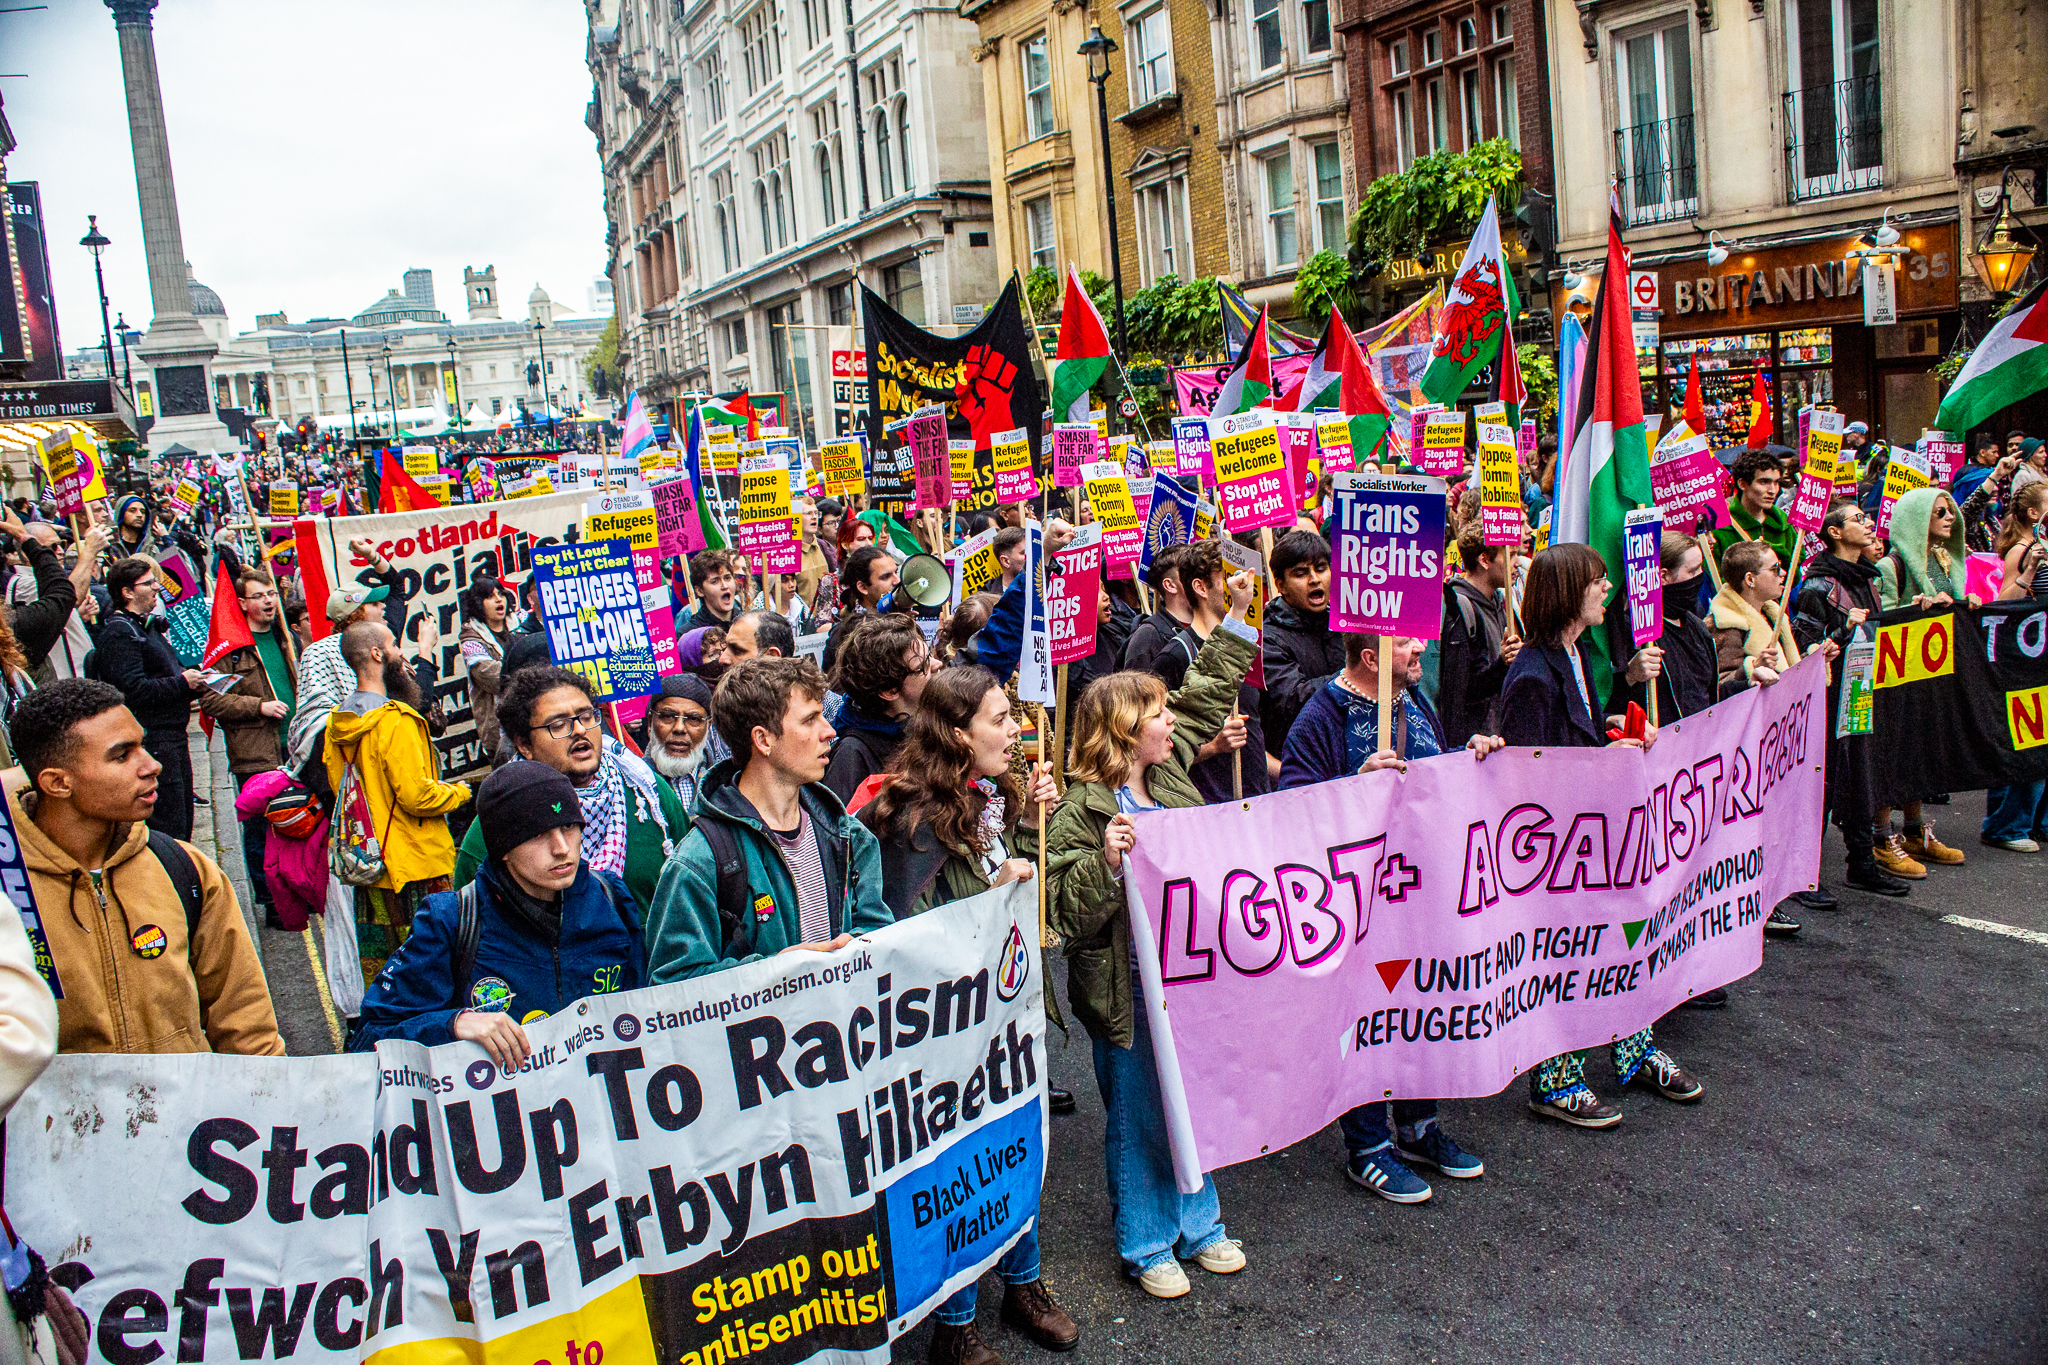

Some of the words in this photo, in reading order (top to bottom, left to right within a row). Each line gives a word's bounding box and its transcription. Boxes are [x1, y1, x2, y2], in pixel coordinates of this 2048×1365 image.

[1391, 252, 1448, 281] SILER
[1909, 252, 1950, 281] 35
[1675, 257, 1868, 315] BRITANNIA
[1873, 315, 1894, 323] BRITANNIA
[877, 341, 968, 390] Socialist
[1857, 391, 1867, 400] 35
[9, 406, 30, 417] FOR
[33, 405, 57, 416] OUR
[1124, 402, 1136, 412] 20
[1236, 416, 1251, 424] STAND
[1245, 420, 1262, 430] RACISM
[912, 418, 943, 440] SMASH
[1058, 432, 1090, 443] SMASH
[1174, 424, 1204, 437] Trans
[1320, 424, 1348, 435] Refugees
[1414, 427, 1425, 436] THE
[1426, 426, 1464, 436] Refugees
[1178, 439, 1212, 456] Rights
[1216, 434, 1276, 458] Refugees
[1322, 434, 1348, 444] welcome
[1426, 436, 1461, 444] welcome
[822, 445, 849, 458] SMASH
[916, 442, 931, 458] THE
[932, 438, 947, 457] FAR
[996, 443, 1028, 457] Refugees
[1059, 444, 1077, 455] THE
[1078, 444, 1094, 454] FAR
[1324, 448, 1340, 458] Stop
[1340, 447, 1350, 456] the
[1424, 450, 1444, 460] Stop
[1446, 449, 1458, 458] the
[1481, 445, 1512, 466] Oppose
[1674, 446, 1694, 459] RACISM
[1928, 442, 1963, 454] JUSTICE
[405, 454, 429, 464] Oppose
[405, 462, 429, 471] Tommy
[824, 457, 856, 470] FASCISM
[996, 455, 1028, 468] welcome
[1058, 456, 1086, 468] RIGHT
[1180, 456, 1202, 470] Now
[1220, 452, 1278, 476] welcome
[1326, 458, 1337, 468] far
[1338, 456, 1352, 468] right
[1424, 460, 1436, 468] far
[1437, 460, 1458, 470] right
[1672, 458, 1691, 470] loud
[1928, 454, 1946, 462] FOR
[834, 468, 862, 482] RACISM
[920, 458, 943, 478] RIGHT
[1482, 466, 1512, 486] Tommy
[1676, 466, 1700, 480] clear:
[65, 476, 79, 492] the
[998, 473, 1020, 485] Stop
[1020, 470, 1030, 481] the
[1890, 465, 1928, 489] Refugees
[507, 488, 532, 500] Oppose
[998, 485, 1014, 496] far
[1014, 482, 1032, 495] right
[1088, 481, 1122, 498] Oppose
[1224, 483, 1258, 502] Stop
[1258, 476, 1280, 490] the
[1654, 472, 1715, 500] Refugees
[1812, 481, 1826, 500] the
[1842, 486, 1855, 494] hate
[271, 498, 290, 506] Tommy
[1482, 486, 1520, 504] Robinson
[1658, 488, 1717, 514] welcome
[271, 506, 297, 514] Robinson
[622, 500, 642, 508] RACISM
[672, 497, 692, 514] FAR
[1092, 498, 1125, 513] Tommy
[1228, 500, 1250, 520] far
[1253, 494, 1284, 516] right
[740, 506, 789, 522] Robinson
[1098, 512, 1138, 529] Robinson
[1336, 492, 1420, 535] Trans
[1483, 508, 1498, 521] Stop
[1498, 508, 1518, 520] fascists
[1663, 510, 1694, 528] here
[592, 514, 654, 532] Refugees
[740, 526, 754, 536] Stop
[755, 522, 786, 533] fascists
[350, 510, 498, 568] Scotland
[758, 536, 771, 544] far
[772, 532, 790, 546] right
[1104, 534, 1119, 544] Stop
[1120, 530, 1138, 542] fascists
[1624, 527, 1654, 560] Trans
[534, 553, 560, 566] Say
[576, 544, 610, 558] Loud
[1225, 552, 1246, 567] RACISM
[1340, 534, 1438, 585] Rights
[554, 564, 579, 577] Say
[595, 556, 630, 570] Clear
[964, 566, 990, 588] THE
[1628, 560, 1660, 600] Rights
[540, 572, 639, 616] REFUGEES
[1340, 576, 1404, 619] Now
[576, 605, 598, 624] ARE
[1631, 598, 1655, 632] Now
[548, 608, 649, 660] WELCOME
[1050, 642, 1071, 652] Lives
[1072, 634, 1093, 648] Matter
[1875, 621, 1950, 685] NO
[1982, 610, 2048, 663] TO
[609, 660, 656, 672] education
[619, 654, 644, 662] national
[1160, 831, 1422, 988] LGBT+
[1457, 752, 1723, 919] AGAINST
[1644, 906, 1666, 948] NO
[1665, 897, 1681, 930] TO
[1659, 916, 1696, 973] SMASH
[1701, 900, 1733, 942] THE
[1738, 890, 1762, 928] FAR
[1414, 946, 1492, 994] UNITE
[1496, 931, 1526, 979] AND
[1531, 923, 1610, 962] FIGHT
[592, 964, 622, 994] Si2
[646, 950, 873, 1036] standuptoracism.org.uk
[1356, 1001, 1493, 1052] REFUGEES
[1494, 970, 1580, 1032] WELCOME
[1584, 960, 1644, 1000] HERE
[180, 1096, 440, 1226] Stand
[443, 1087, 580, 1202] Up
[587, 1046, 704, 1142] To
[725, 968, 990, 1112] Racism
[426, 1228, 551, 1325] Yn
[568, 1142, 816, 1288] Erbyn
[836, 1020, 1037, 1198] Hiliaeth
[912, 1167, 976, 1229] Black
[976, 1136, 1028, 1188] Lives
[946, 1192, 1010, 1258] Matter
[692, 1254, 812, 1324] Stamp
[822, 1234, 881, 1280] out
[566, 1338, 604, 1365] to
